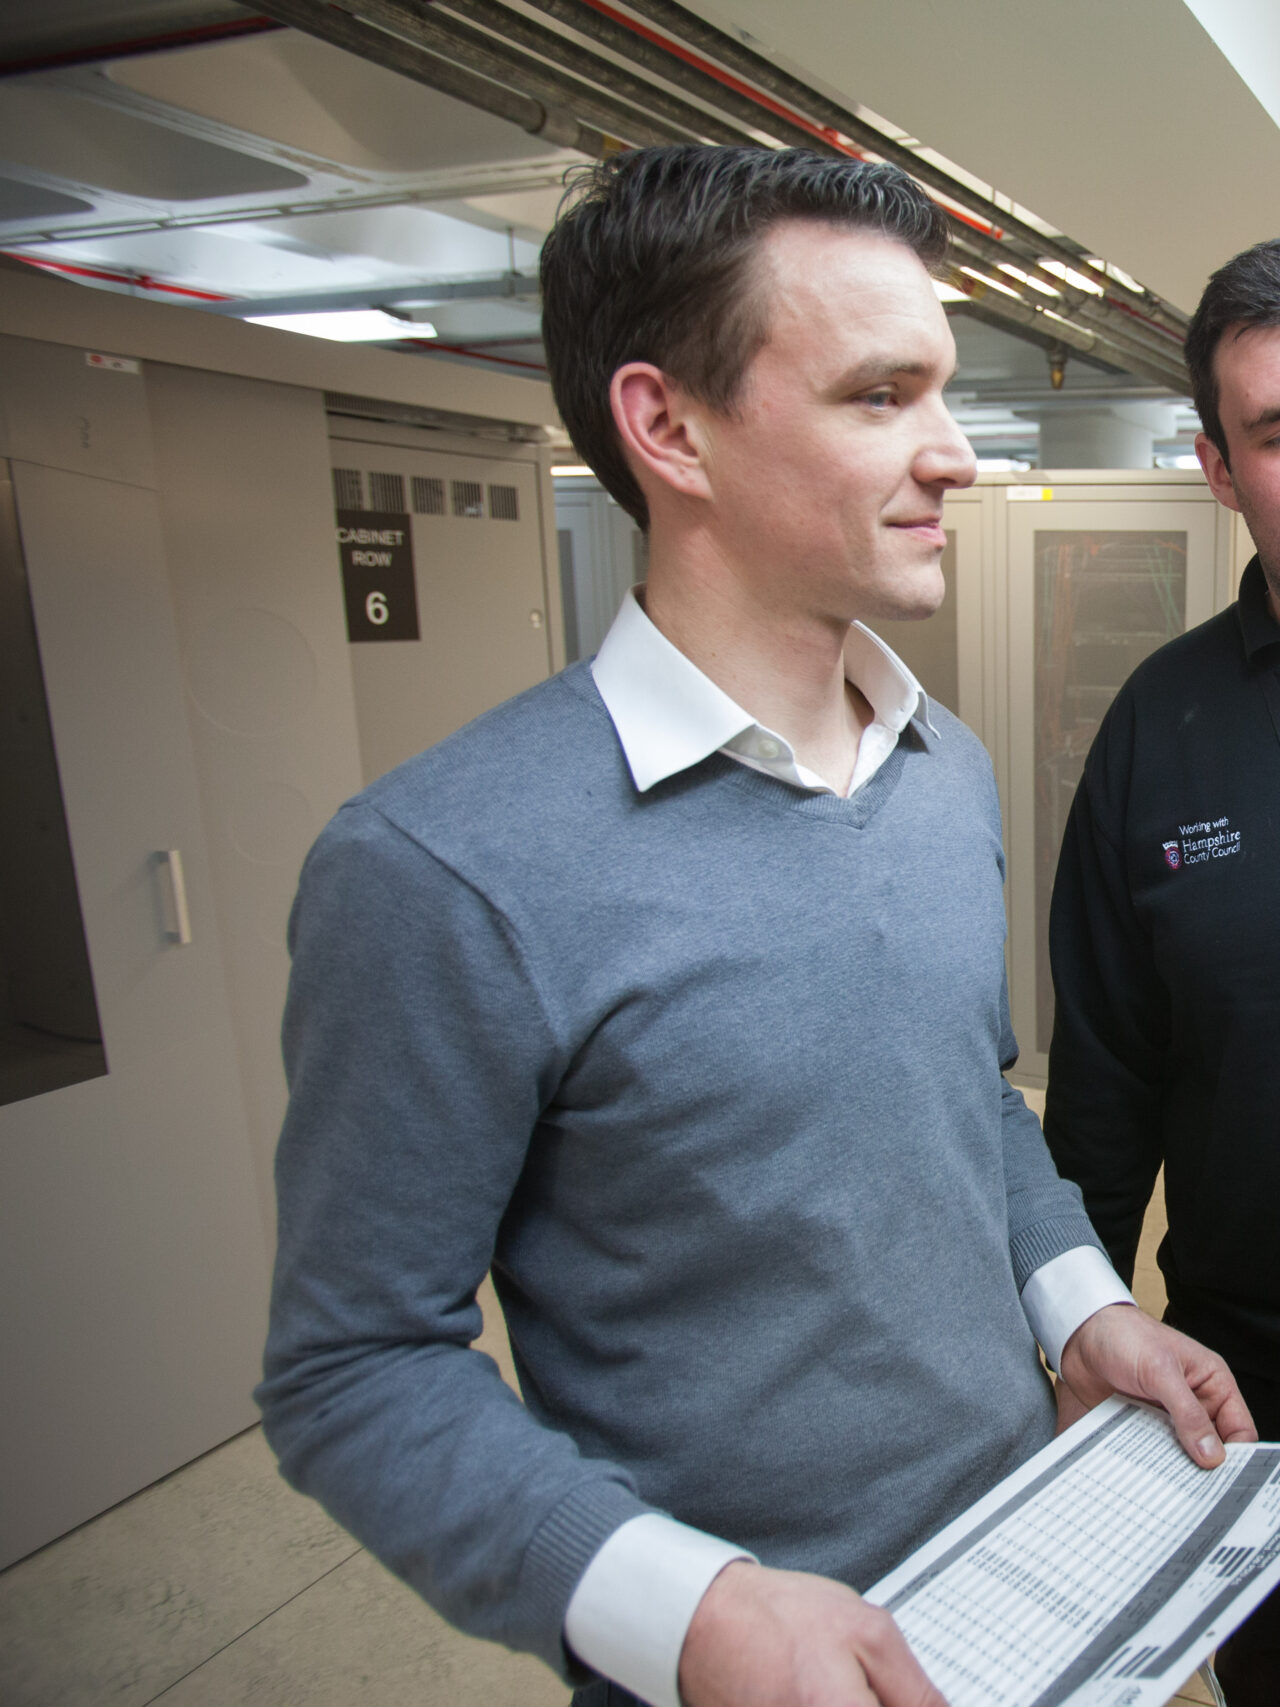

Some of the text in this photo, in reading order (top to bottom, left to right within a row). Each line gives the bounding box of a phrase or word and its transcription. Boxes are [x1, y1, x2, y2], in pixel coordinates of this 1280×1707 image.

[336, 527, 404, 546] CABINET
[352, 550, 392, 567] ROW
[366, 591, 389, 625] 6
[1179, 816, 1229, 836] Working with
[1182, 830, 1241, 853] Hampshire
[1184, 841, 1240, 864] County Council
